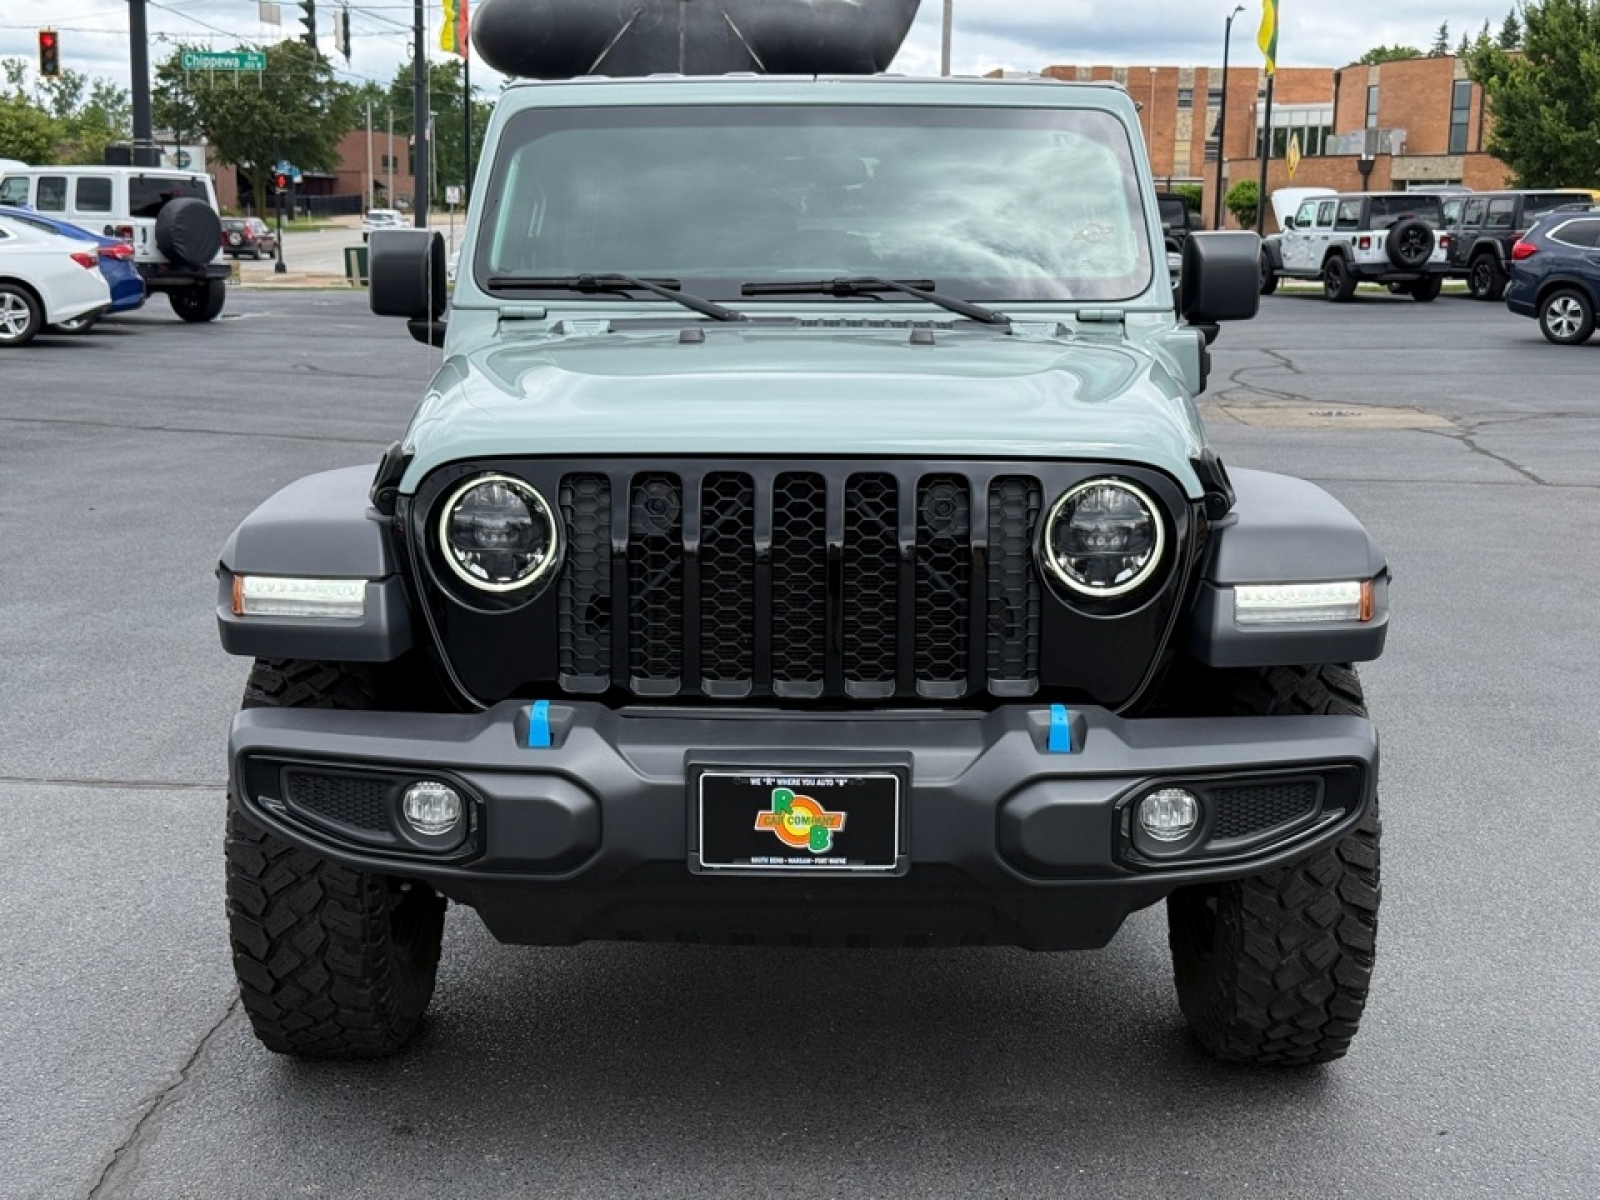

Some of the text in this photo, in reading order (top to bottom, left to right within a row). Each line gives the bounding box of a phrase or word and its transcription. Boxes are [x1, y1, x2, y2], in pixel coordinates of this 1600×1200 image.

[184, 54, 240, 69] Chippewa
[750, 778, 761, 786] WE
[776, 778, 800, 786] WHERE
[801, 778, 815, 786] YOU
[816, 778, 834, 786] AUTO
[772, 788, 794, 814] R
[764, 815, 836, 826] CAR COMPANY
[808, 825, 833, 853] B
